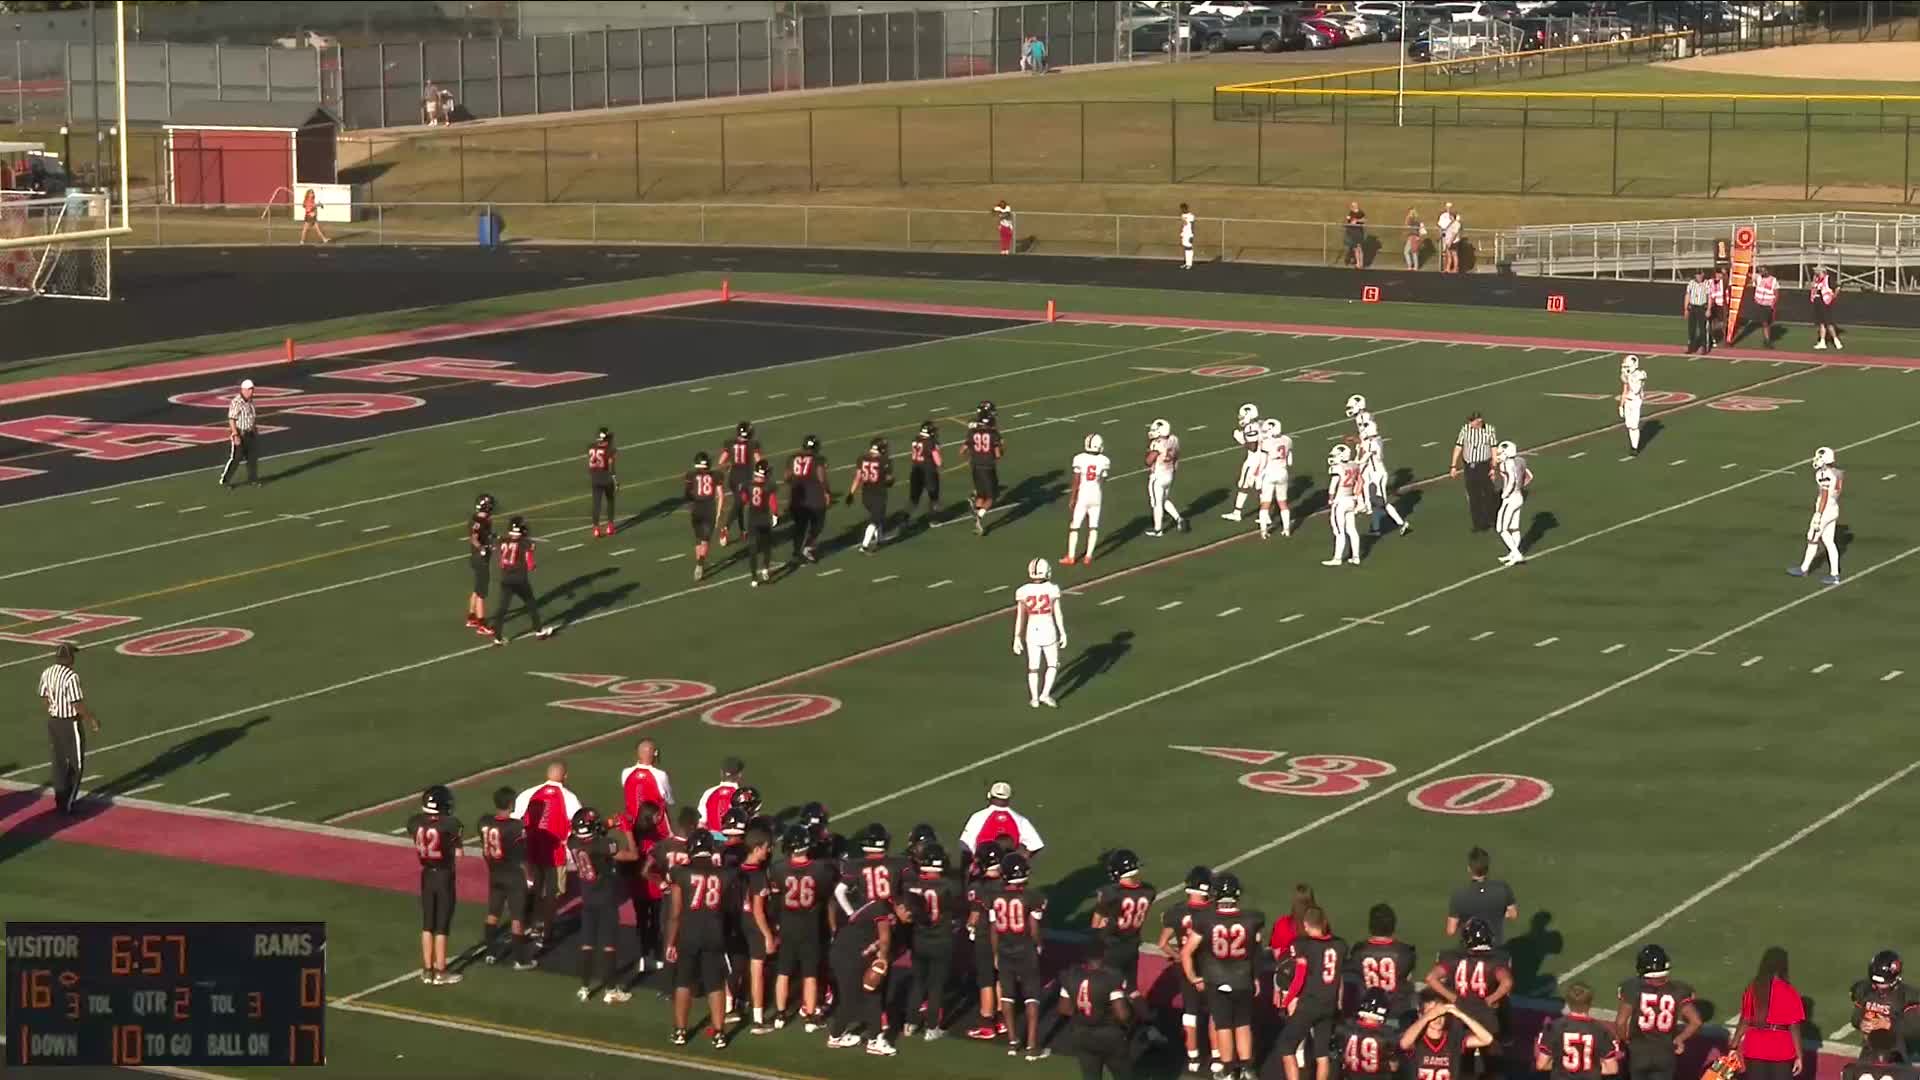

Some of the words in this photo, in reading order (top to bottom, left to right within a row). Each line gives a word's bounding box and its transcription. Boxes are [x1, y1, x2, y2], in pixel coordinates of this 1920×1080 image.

[588, 448, 604, 468] 25
[733, 444, 747, 464] 11
[972, 431, 991, 453] 99
[792, 456, 812, 477] 67
[861, 460, 879, 482] 55
[1086, 464, 1097, 481] 6
[695, 474, 713, 496] 18
[752, 486, 762, 505] 8
[500, 542, 518, 568] 27
[1026, 594, 1052, 614] 22
[415, 826, 441, 853] 42
[689, 873, 721, 911] 78
[784, 875, 815, 909] 26
[861, 866, 890, 899] 16
[993, 898, 1025, 934] 30
[1116, 897, 1149, 930] 38
[1211, 922, 1247, 959] 62
[1320, 948, 1338, 982] 9
[1363, 956, 1396, 992] 69
[1454, 959, 1486, 998] 44
[1637, 993, 1674, 1032] 58
[1343, 1036, 1379, 1073] 49
[1562, 1034, 1593, 1072] 51
